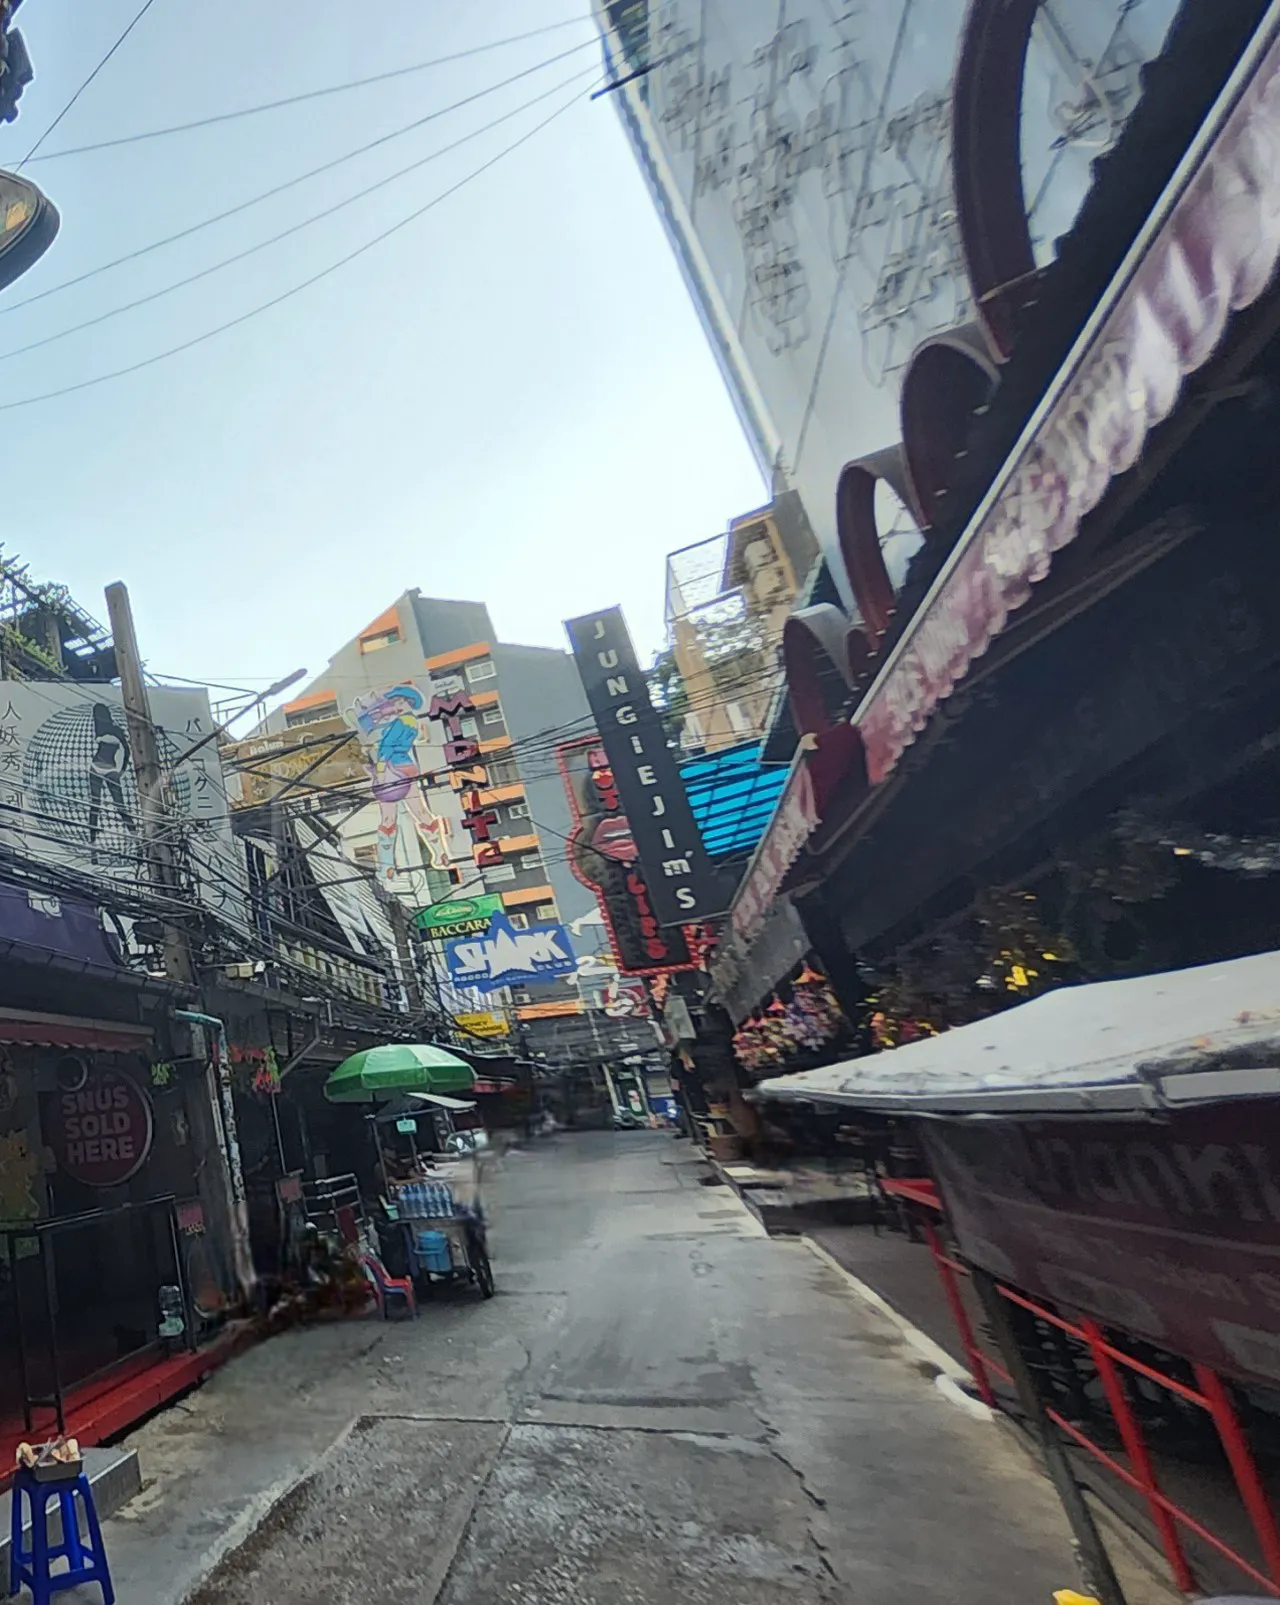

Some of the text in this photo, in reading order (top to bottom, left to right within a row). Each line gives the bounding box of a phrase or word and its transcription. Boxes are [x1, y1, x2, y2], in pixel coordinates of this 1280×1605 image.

[430, 917, 492, 939] BACCARA
[453, 928, 569, 980] SHARK
[61, 1085, 130, 1115] SNUS
[64, 1111, 132, 1140] SOLD
[66, 1135, 135, 1165] HERE
